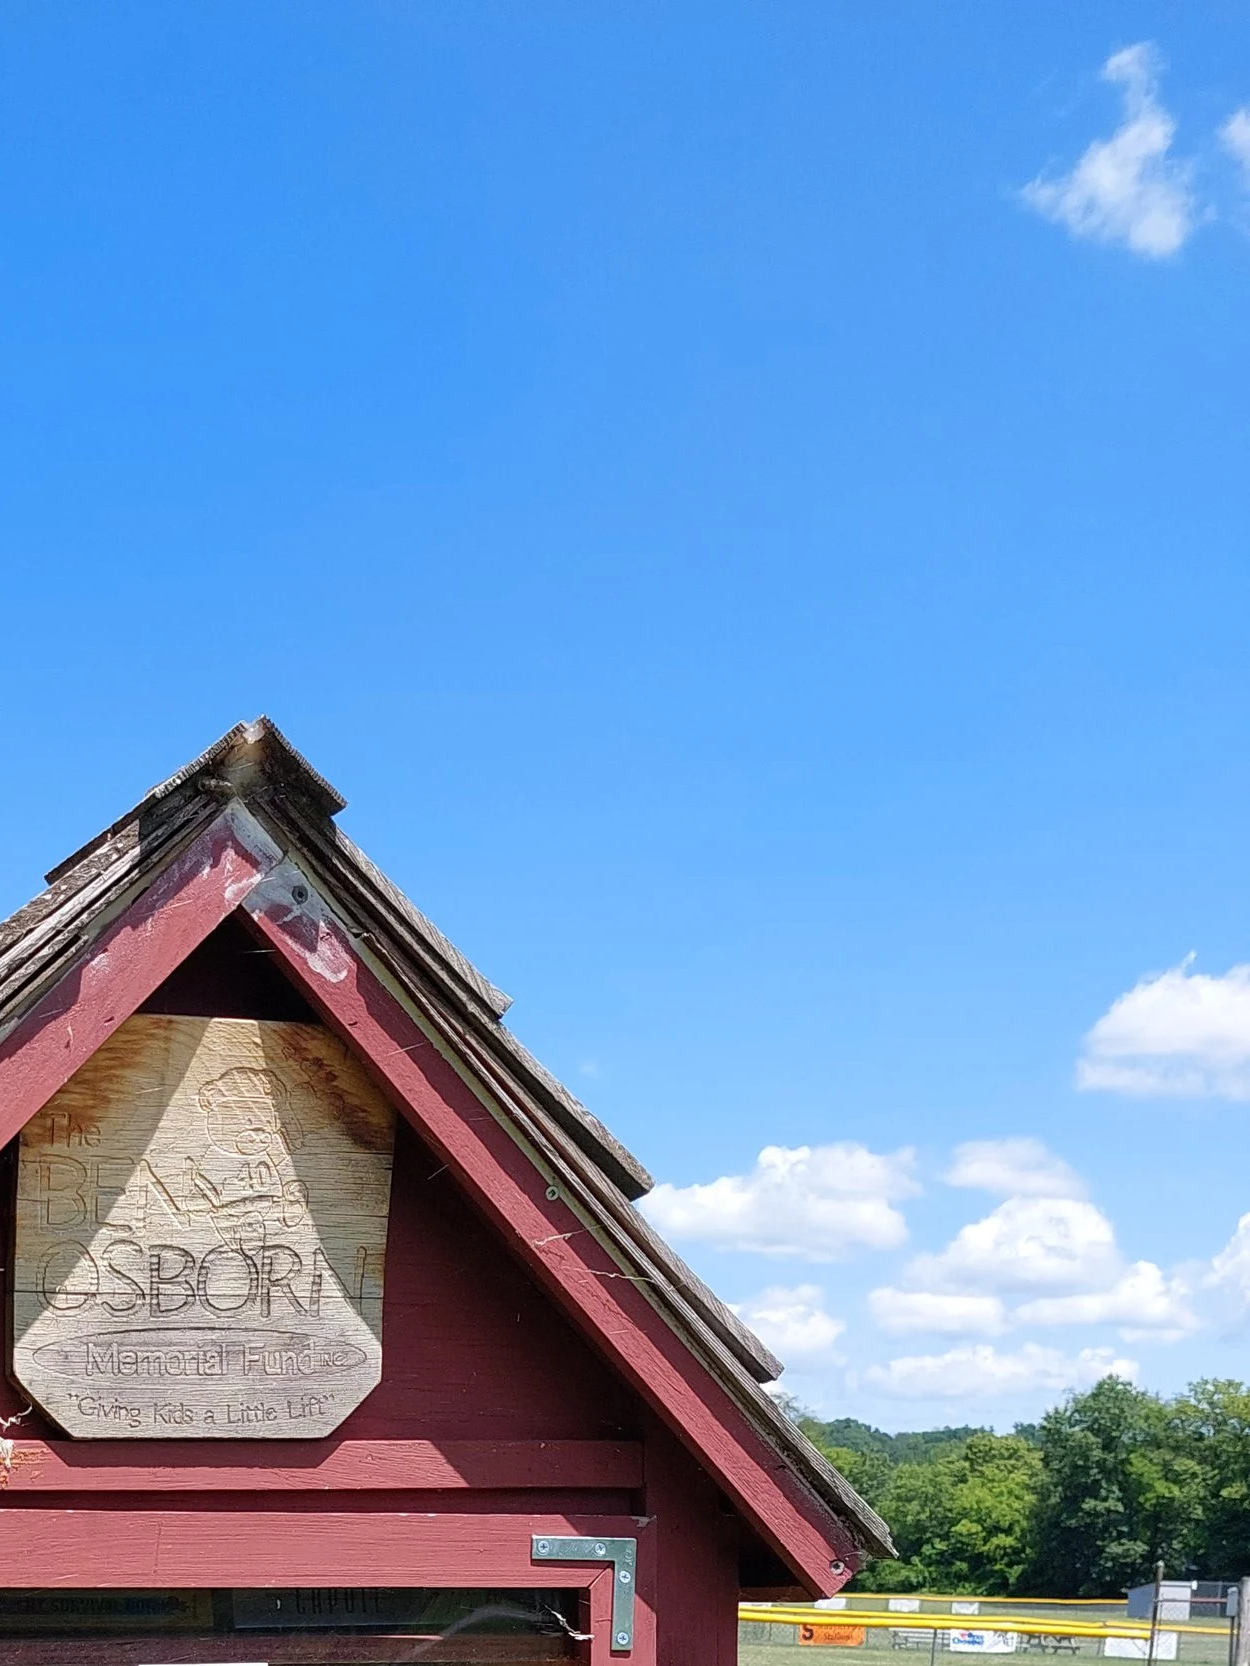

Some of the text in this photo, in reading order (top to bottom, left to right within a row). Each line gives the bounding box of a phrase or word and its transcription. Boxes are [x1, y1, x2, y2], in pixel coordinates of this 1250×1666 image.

[40, 1111, 101, 1148] The
[36, 1239, 367, 1318] OSBORN
[84, 1341, 229, 1377] Memorial
[242, 1342, 318, 1377] Fund
[153, 1401, 200, 1425] Kids
[204, 1408, 217, 1425] a
[227, 1401, 278, 1424] Little
